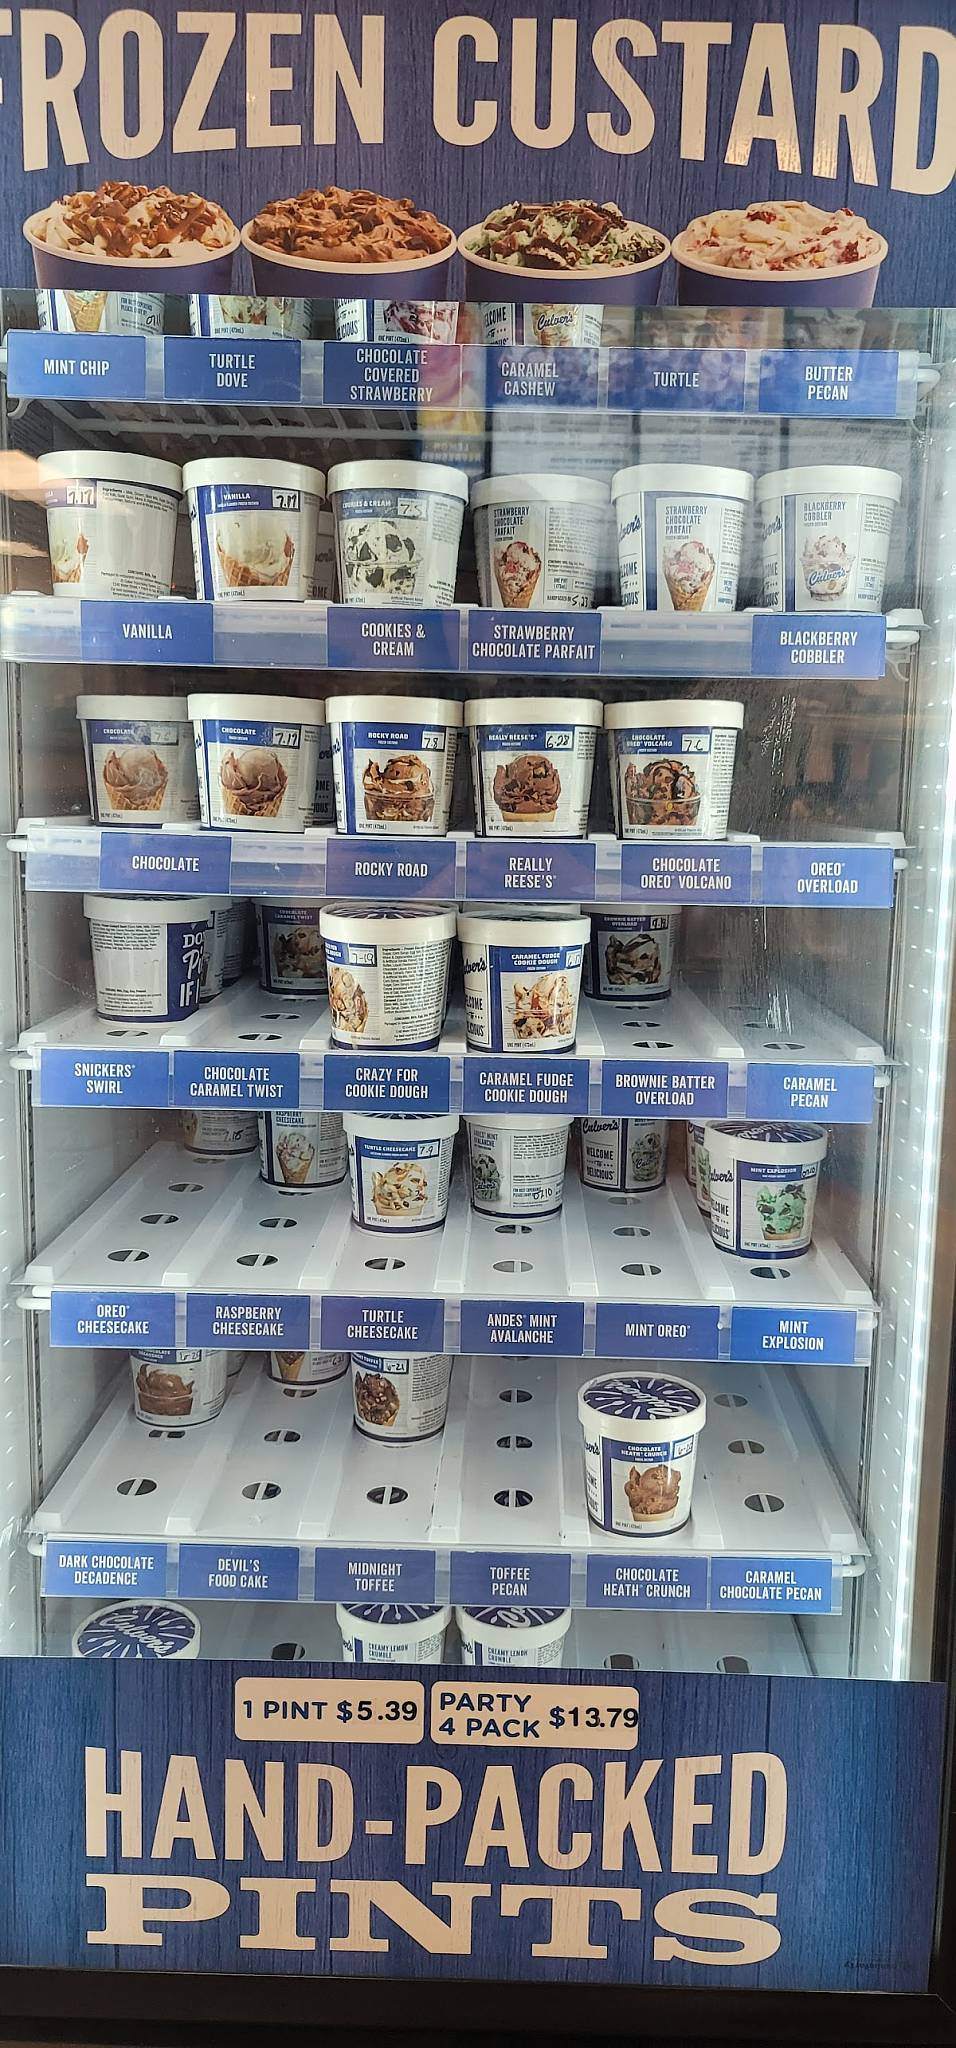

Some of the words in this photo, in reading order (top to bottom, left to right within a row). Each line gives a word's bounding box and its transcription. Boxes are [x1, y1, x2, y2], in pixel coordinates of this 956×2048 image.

[0, 9, 386, 172] ROZEN
[433, 15, 956, 196] CUSTARD
[537, 312, 575, 330] Culver's
[209, 353, 256, 370] TURTLE
[356, 348, 428, 365] CHOCOLATE
[44, 359, 76, 375] MINT
[80, 360, 110, 376] CHIP
[364, 367, 420, 383] COVERED
[501, 362, 559, 378] CARAMEL
[805, 366, 853, 382] BUTTER
[216, 372, 248, 388] DOVE
[653, 371, 700, 388] TURTLE
[350, 385, 433, 402] STRAWBERRY
[504, 380, 556, 397] CASHEW
[807, 384, 848, 401] PECAN
[223, 493, 251, 501] VANILLA
[493, 506, 530, 518] STRAWBERRY
[665, 505, 708, 515] STRAWBERRY
[803, 501, 847, 512] BLACKBERRY
[494, 516, 525, 527] CHOCOLATE
[665, 515, 701, 525] CHOCOLATE
[803, 512, 832, 521] COBBLER
[495, 526, 516, 536] PARFAIT
[665, 525, 692, 535] PARFAIT
[809, 568, 847, 586] Culver's
[122, 623, 173, 640] VANILLA
[361, 623, 412, 639] COOKIES
[415, 624, 426, 639] &
[494, 624, 574, 641] STRAWBERRY
[780, 631, 858, 647] BLACKBERRY
[373, 641, 414, 657] CREAM
[472, 642, 541, 659] CHOCOLATE
[545, 644, 596, 660] PARFAIT
[790, 649, 845, 664] COBBLER
[221, 727, 257, 736] CHOCOLATE
[132, 855, 200, 872] CHOCOLATE
[355, 861, 393, 876] ROCKY
[397, 862, 428, 877] ROAD
[509, 857, 553, 871] REALLY
[652, 857, 721, 872] CHOCOLATE
[678, 875, 732, 890] VOLCANO
[797, 878, 858, 894] OVERLOAD
[204, 1066, 270, 1081] CHOCOLATE
[355, 1067, 392, 1081] CRAZY
[396, 1068, 418, 1082] FOR
[479, 1072, 532, 1087] CARAMEL
[536, 1072, 574, 1087] FUDGE
[86, 1079, 123, 1094] SWIRL
[615, 1074, 668, 1089] BROWNIE
[672, 1075, 716, 1090] BATTER
[783, 1077, 838, 1092] CARAMEL
[190, 1082, 243, 1097] CARAMEL
[247, 1084, 283, 1098] TWIST
[345, 1084, 385, 1098] COOKIE
[390, 1085, 428, 1099] DOUGH
[484, 1089, 525, 1103] COOKIE
[529, 1089, 568, 1103] DOUGH
[635, 1091, 694, 1106] OVERLOAD
[790, 1094, 829, 1108] PECAN
[582, 1118, 620, 1134] Culver's
[586, 1146, 614, 1160] WELCOME
[215, 1305, 282, 1320] RASPBERRY
[362, 1309, 404, 1324] TURTLE
[77, 1320, 150, 1335] CHEESECAKE
[212, 1321, 284, 1336] CHEESECAKE
[529, 1314, 558, 1328] MINT
[779, 1320, 809, 1334] MINT
[347, 1325, 418, 1340] CHEESECAKE
[490, 1329, 554, 1344] AVALANCHE
[625, 1323, 655, 1337] MINT
[762, 1335, 824, 1350] EXPLOSION
[59, 1554, 88, 1568] DARK
[91, 1555, 154, 1570] CHOCOLATE
[218, 1558, 260, 1572] DEVIL'S
[348, 1562, 402, 1576] MIDNIGHT
[74, 1571, 138, 1585] DECADENCE
[490, 1566, 530, 1581] TOFFEE
[615, 1567, 679, 1582] CHOCOLATE
[745, 1570, 797, 1585] CARAMEL
[208, 1574, 237, 1588] FOOD
[240, 1575, 268, 1589] CAKE
[355, 1578, 395, 1592] TOFFEE
[492, 1583, 528, 1597] PECAN
[646, 1584, 691, 1599] CRUNCH
[719, 1585, 782, 1600] CHOCOLATE
[785, 1586, 822, 1601] PECAN
[368, 1650, 392, 1659] CRUMBLE
[487, 1647, 508, 1655] CREAMY
[487, 1655, 512, 1664] CRUMBLE
[440, 1692, 532, 1713] PARTY
[243, 1700, 252, 1719] 1
[264, 1700, 326, 1721] PINT
[336, 1699, 418, 1723] $5.39
[548, 1706, 640, 1730] $13.79
[439, 1717, 456, 1737] 4
[466, 1718, 540, 1739] PACK
[84, 1745, 789, 1876] HAND-PACKED
[86, 1873, 783, 1966] PINTS
